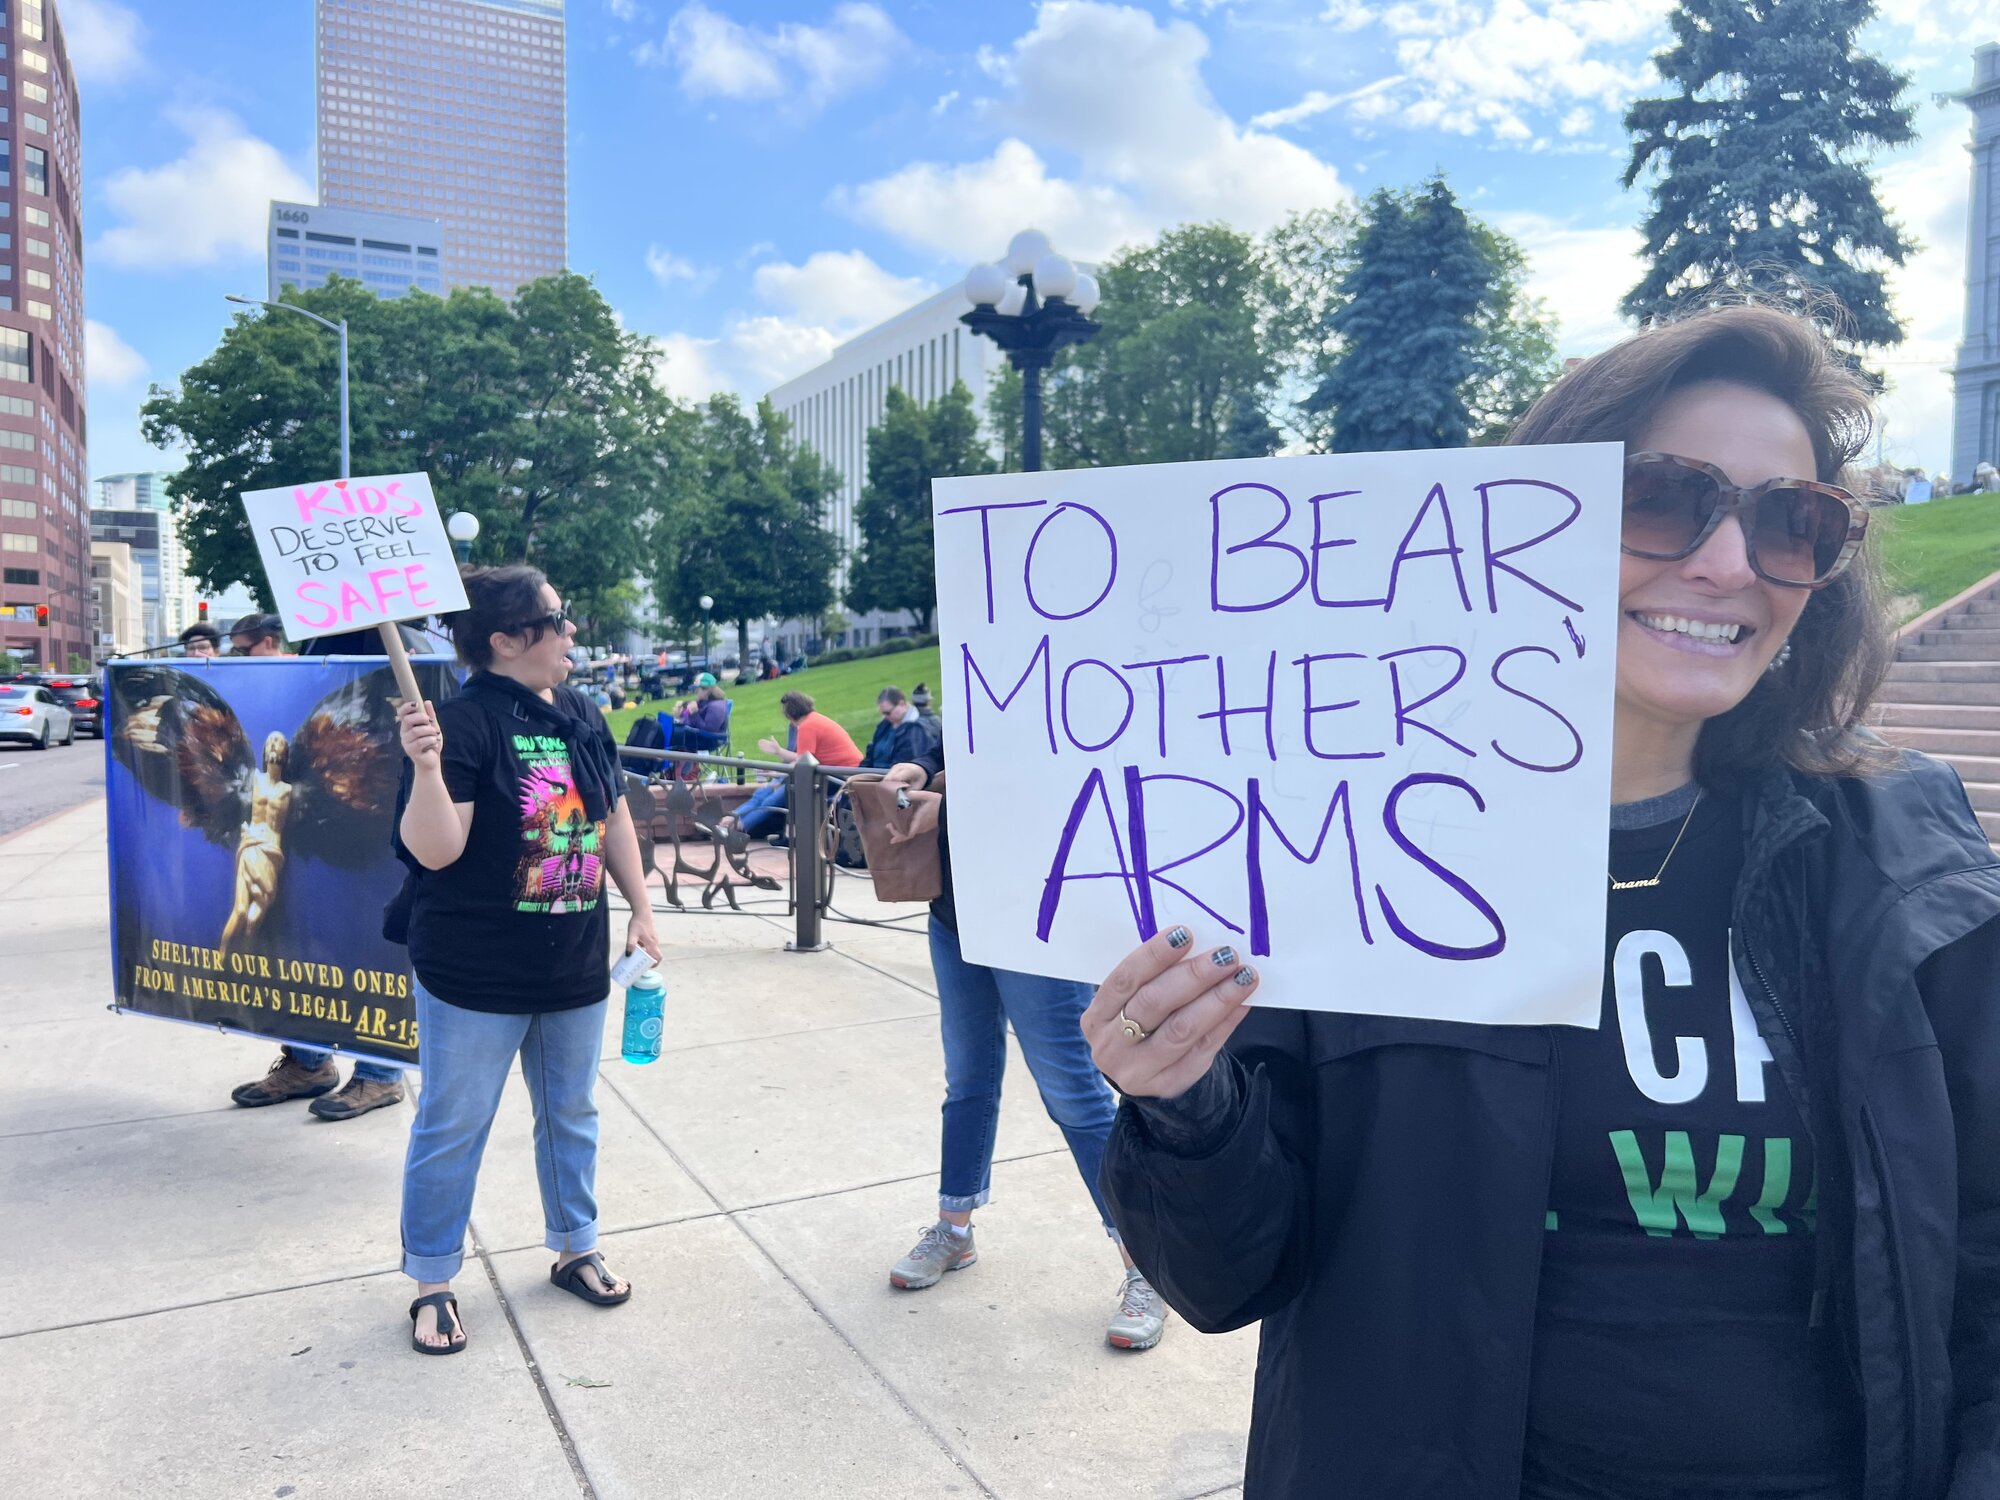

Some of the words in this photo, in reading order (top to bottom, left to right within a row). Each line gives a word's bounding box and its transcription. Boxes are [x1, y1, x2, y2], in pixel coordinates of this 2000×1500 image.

[277, 208, 309, 224] 1660
[270, 515, 416, 556] DESERVE
[293, 552, 339, 575] TO
[354, 540, 431, 566] FEEL
[939, 500, 1117, 623] TO
[1210, 479, 1584, 613] BEAR
[295, 565, 437, 628] SAFE
[960, 616, 1585, 772] MOTHERS'
[1036, 765, 1506, 960] ARMS
[1612, 878, 1660, 890] mama
[152, 939, 224, 971] SHELTER
[231, 952, 272, 979] OUR
[278, 958, 344, 989] LOVED
[353, 968, 408, 999] ONES
[134, 965, 175, 992] FROM
[182, 975, 281, 1011] AMERICA'S
[289, 991, 352, 1023] LEGAL
[354, 1005, 419, 1049] AR-15
